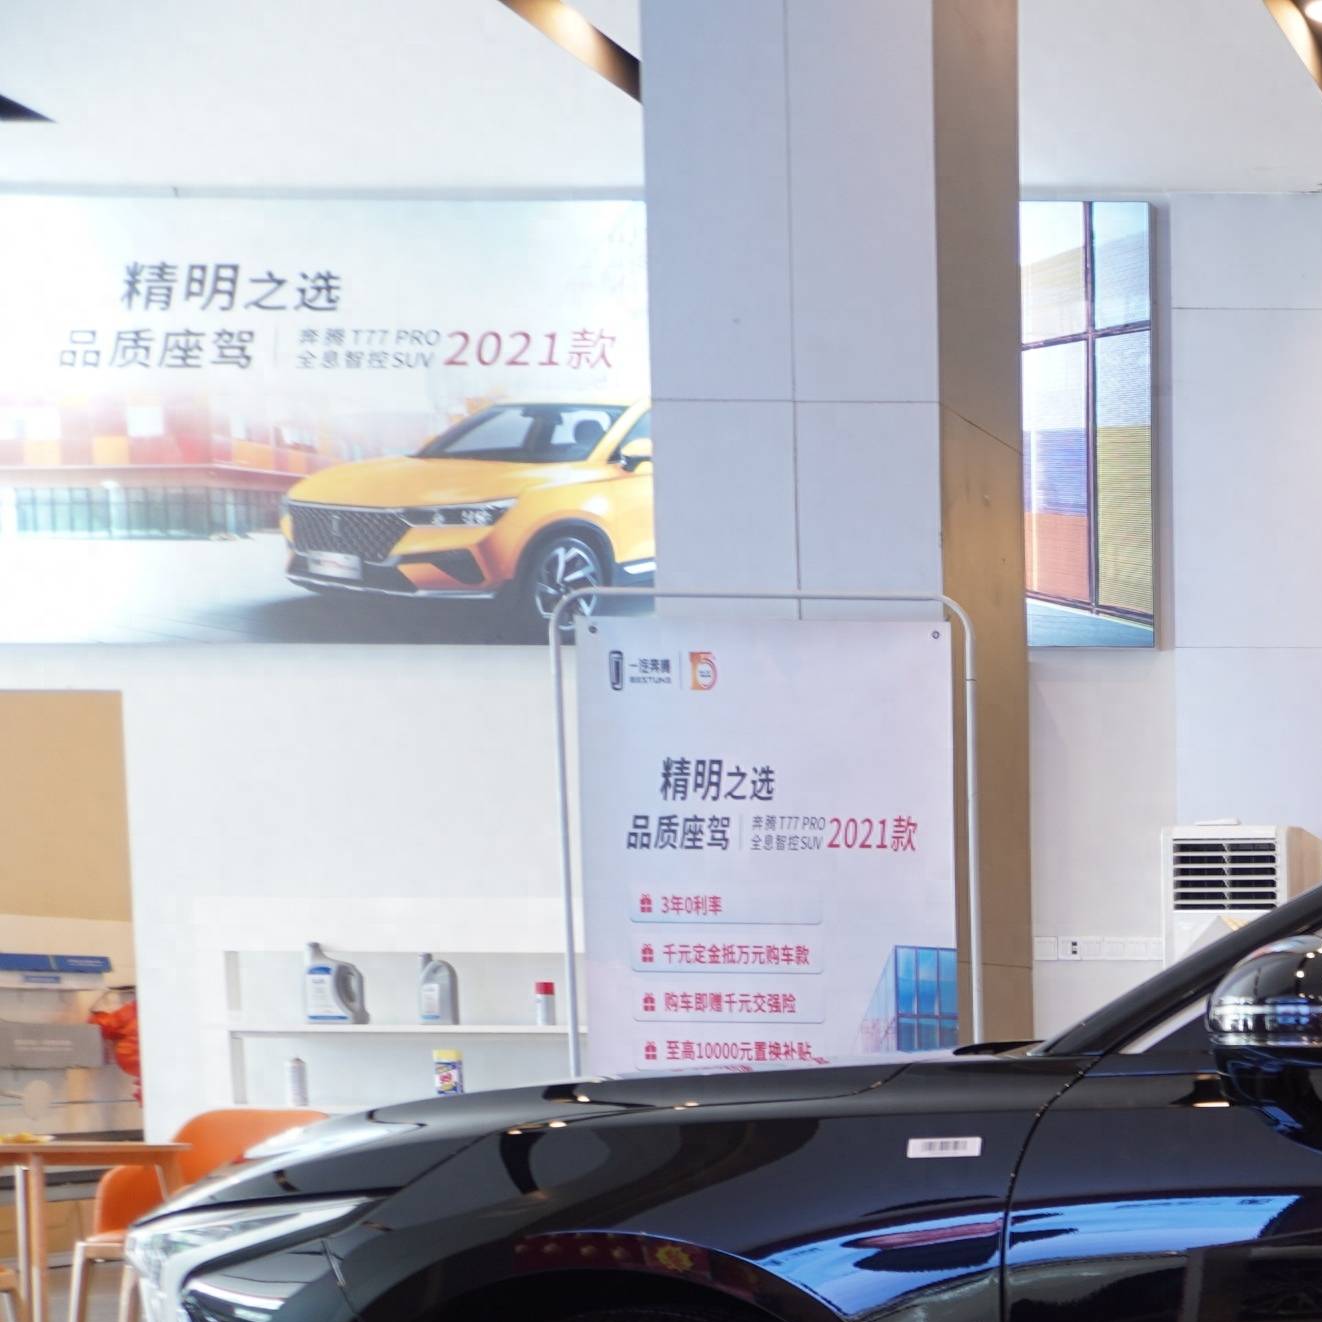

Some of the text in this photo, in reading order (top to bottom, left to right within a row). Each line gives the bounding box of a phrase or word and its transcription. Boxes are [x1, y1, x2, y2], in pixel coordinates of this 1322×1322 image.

[121, 261, 341, 312] 精明之选
[395, 328, 441, 347] PRO
[59, 328, 256, 370] 品质座驾
[296, 350, 437, 370] 全息智控SUV
[443, 328, 617, 370] 2021款
[660, 757, 775, 801] 精明之选
[626, 814, 731, 851] 品质座驾
[801, 816, 826, 831] PRO
[827, 815, 918, 852] 2021款
[751, 834, 823, 851] 全息智控SUV
[660, 895, 723, 915] 3年0利率
[663, 944, 811, 966] 千元定金抵万元购车款
[664, 992, 797, 1014] 购车即赠千元交强险
